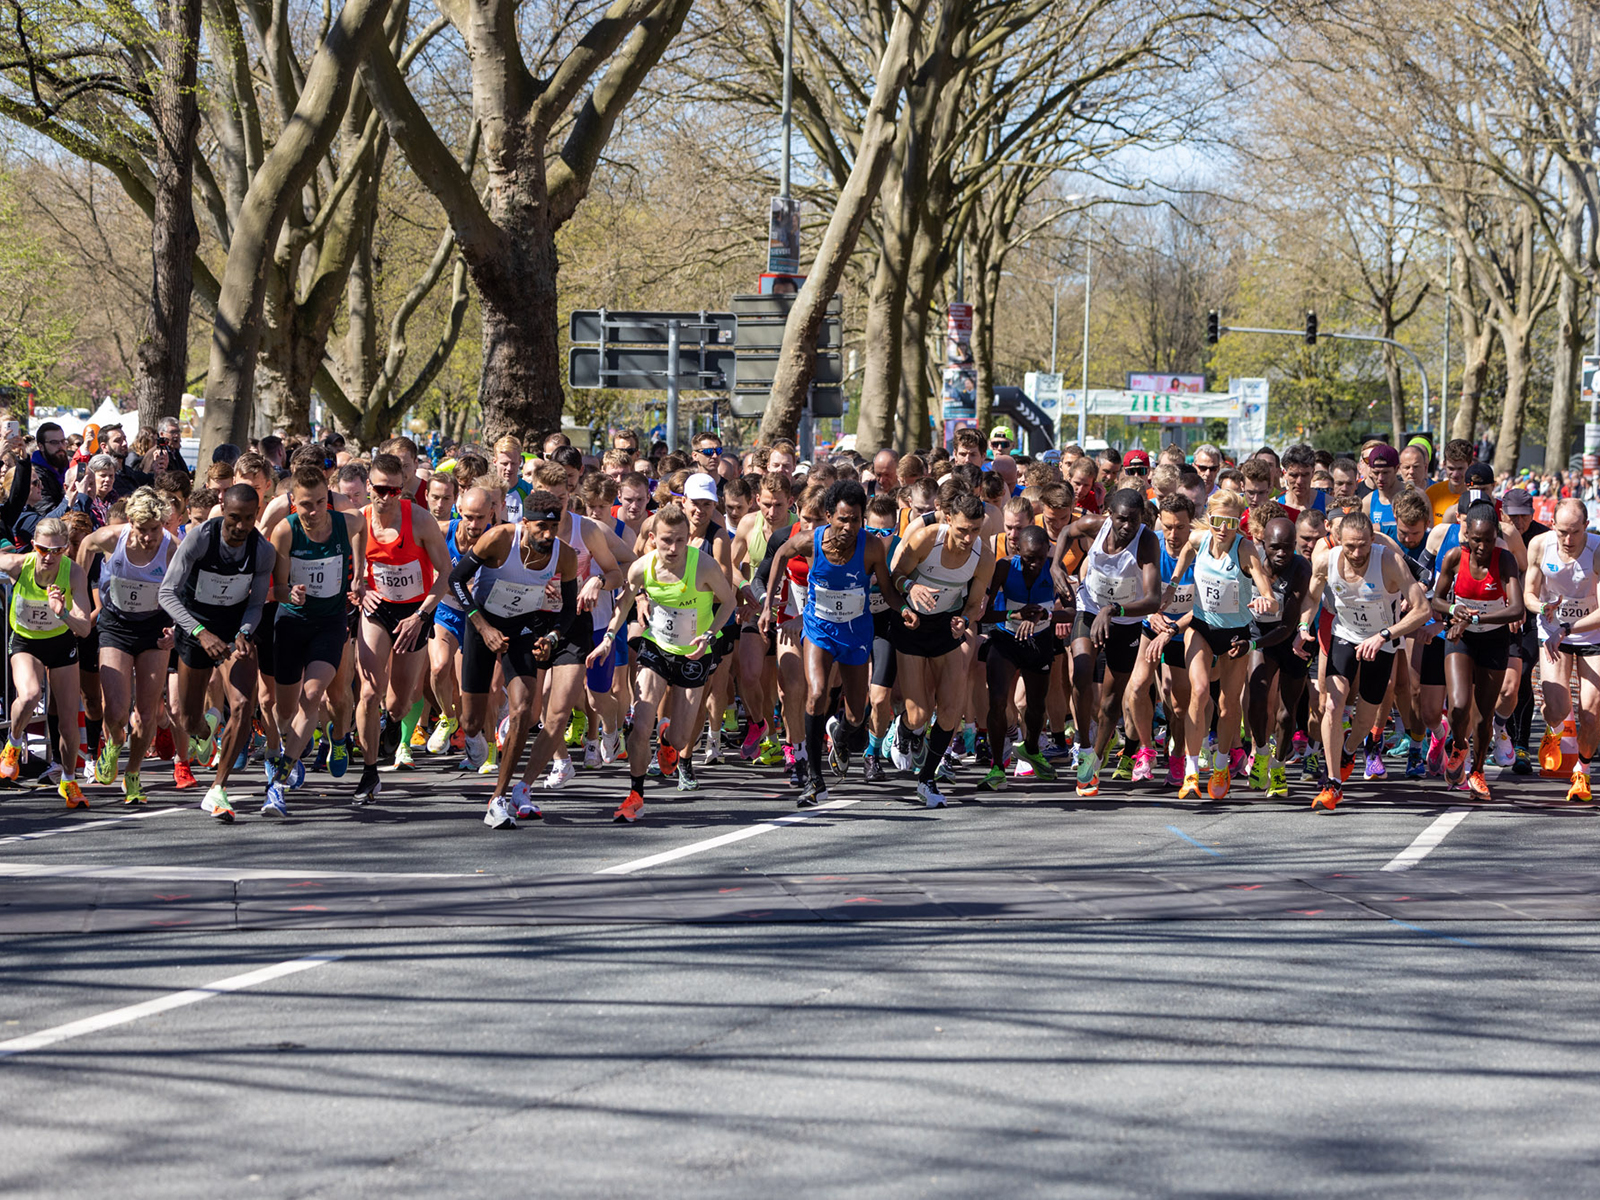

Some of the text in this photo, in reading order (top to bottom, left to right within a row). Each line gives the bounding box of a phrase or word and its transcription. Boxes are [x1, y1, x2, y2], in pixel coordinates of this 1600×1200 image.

[1131, 395, 1172, 412] ZIEL
[309, 572, 324, 584] 10
[381, 574, 414, 587] 15201
[220, 586, 228, 594] 7
[1206, 586, 1220, 600] F3
[130, 591, 138, 600] 6
[511, 596, 521, 606] 2
[679, 597, 698, 606] AMT
[836, 601, 842, 610] 8
[32, 610, 48, 620] F2
[1353, 612, 1368, 622] 14
[666, 620, 674, 630] 3
